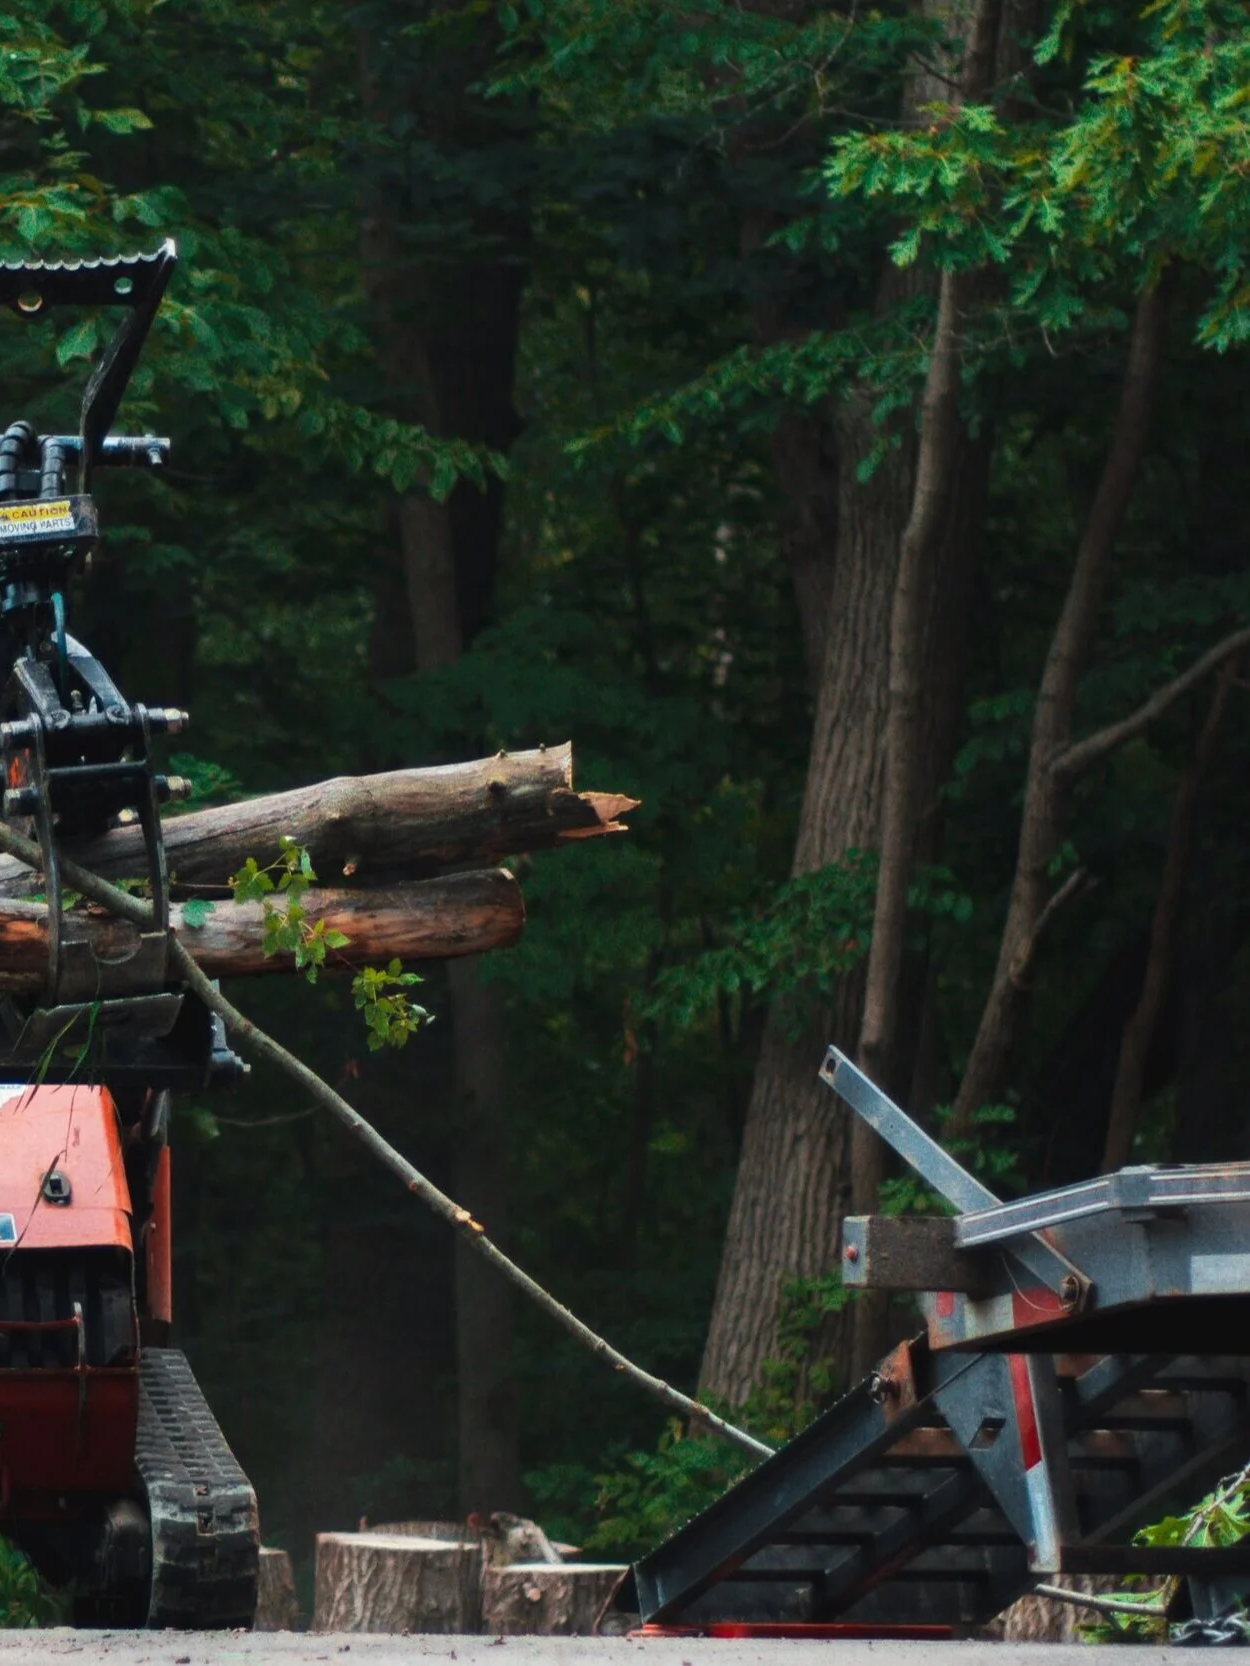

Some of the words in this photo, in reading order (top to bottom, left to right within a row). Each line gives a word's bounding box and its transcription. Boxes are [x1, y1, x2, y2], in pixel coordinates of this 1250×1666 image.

[12, 506, 67, 519] CAUTION
[0, 521, 37, 533] MOVING
[40, 518, 71, 529] PARTS
